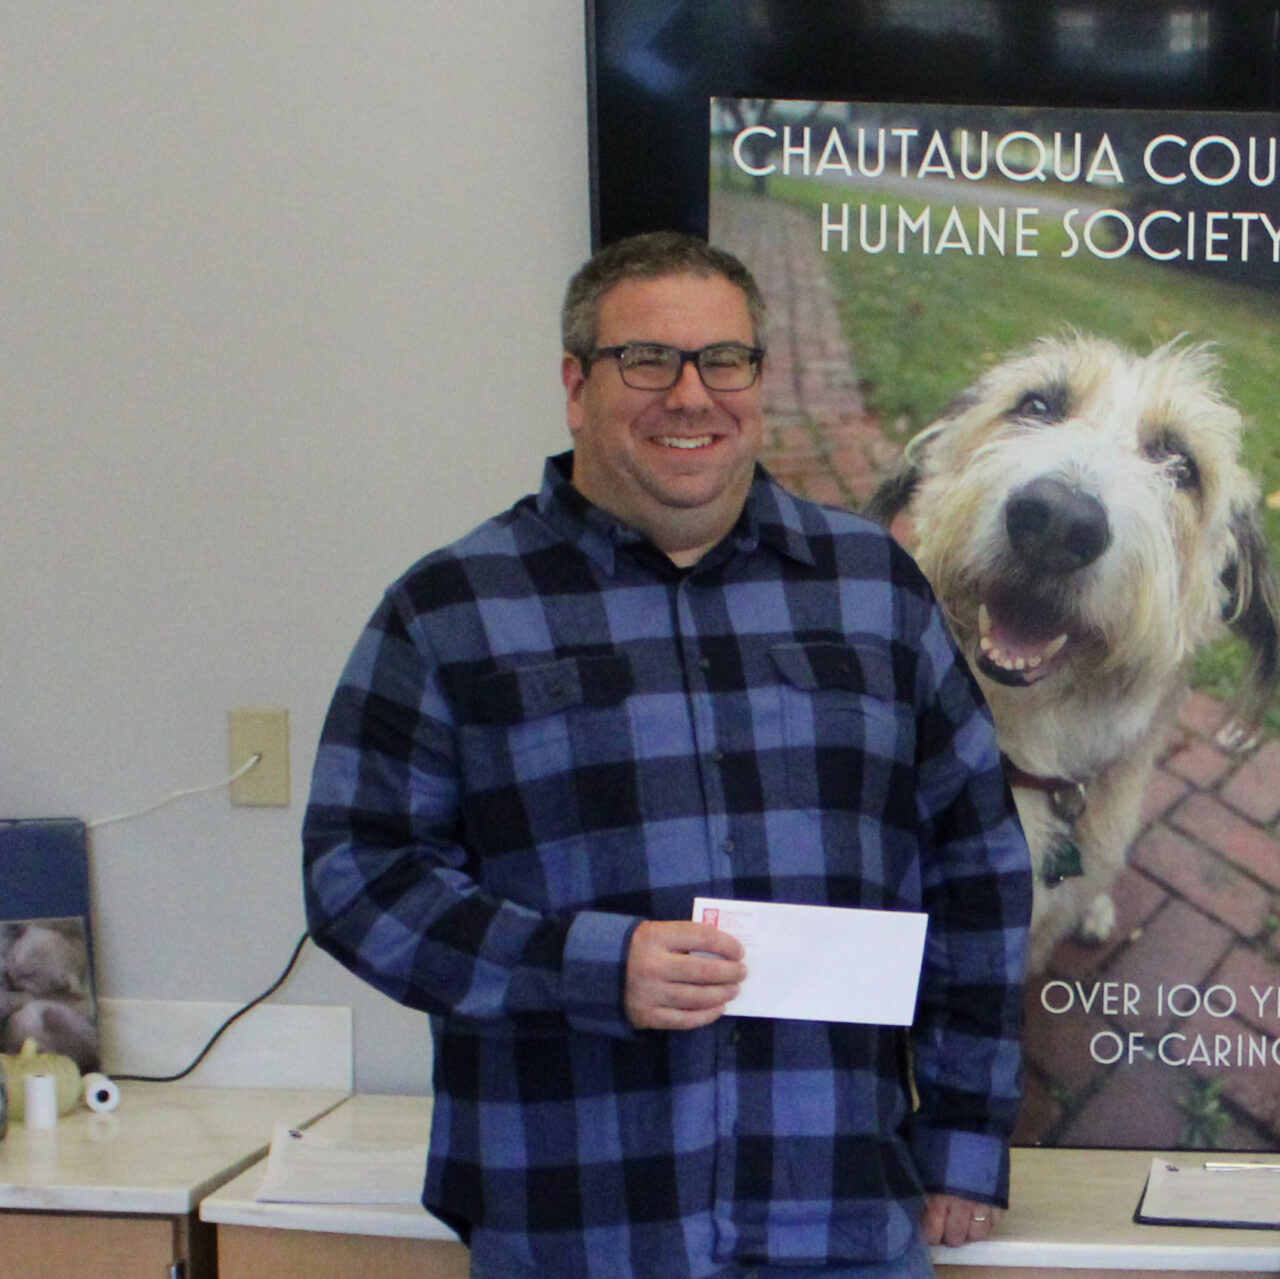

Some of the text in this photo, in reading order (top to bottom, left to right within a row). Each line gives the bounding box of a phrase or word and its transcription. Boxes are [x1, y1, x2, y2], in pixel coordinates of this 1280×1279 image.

[732, 125, 1125, 184] CHAUTAUQUA
[821, 202, 1039, 257] HUMANE
[1040, 980, 1141, 1016] OVER
[1157, 984, 1238, 1018] 100
[1090, 1031, 1145, 1065] OF
